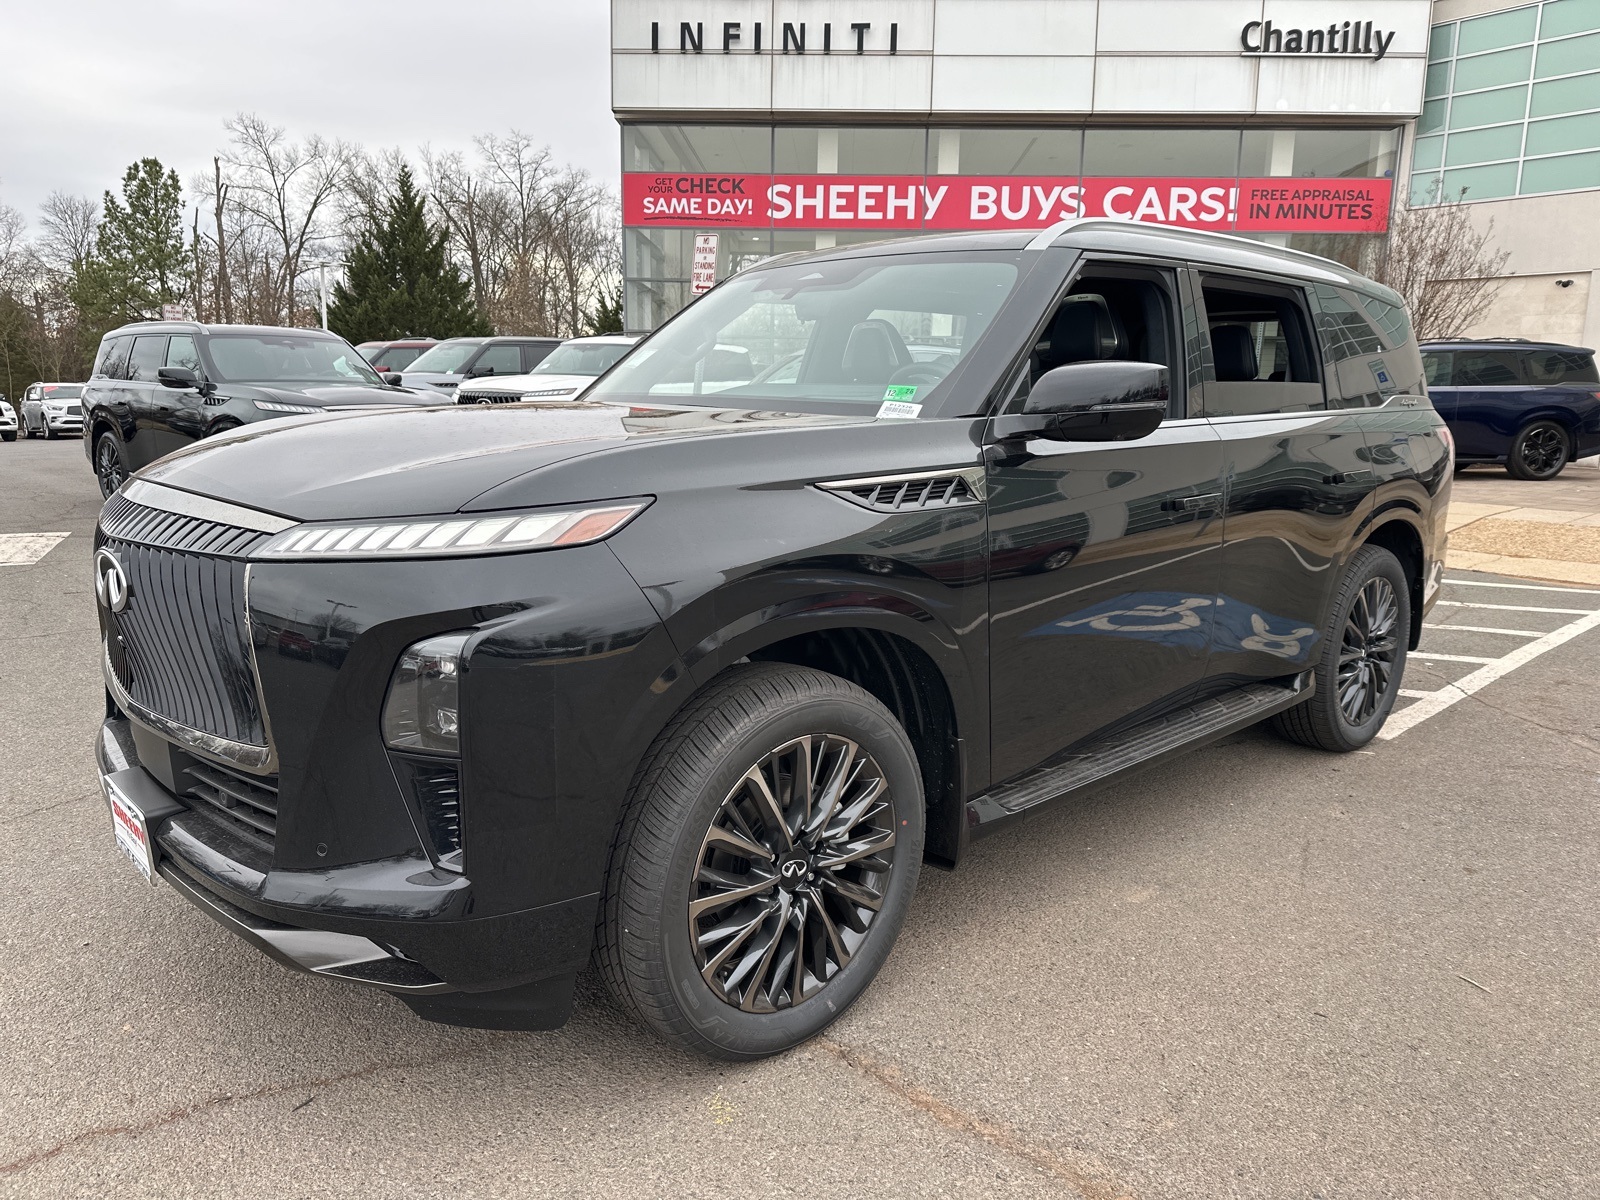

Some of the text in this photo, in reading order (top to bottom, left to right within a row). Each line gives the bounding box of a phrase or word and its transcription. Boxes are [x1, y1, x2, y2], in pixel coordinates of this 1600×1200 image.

[651, 22, 898, 54] INFINITI
[1241, 20, 1396, 61] Chantilly
[648, 186, 673, 194] YOUR
[655, 177, 673, 186] GET
[675, 177, 746, 194] CHECK
[766, 183, 1241, 223] SHEEHY BUYS CARS!
[1251, 189, 1375, 202] FREE APPRAISAL
[643, 197, 753, 215] SAME DAY!
[1249, 203, 1373, 220] IN MINUTES
[693, 272, 714, 283] FIRE LANE
